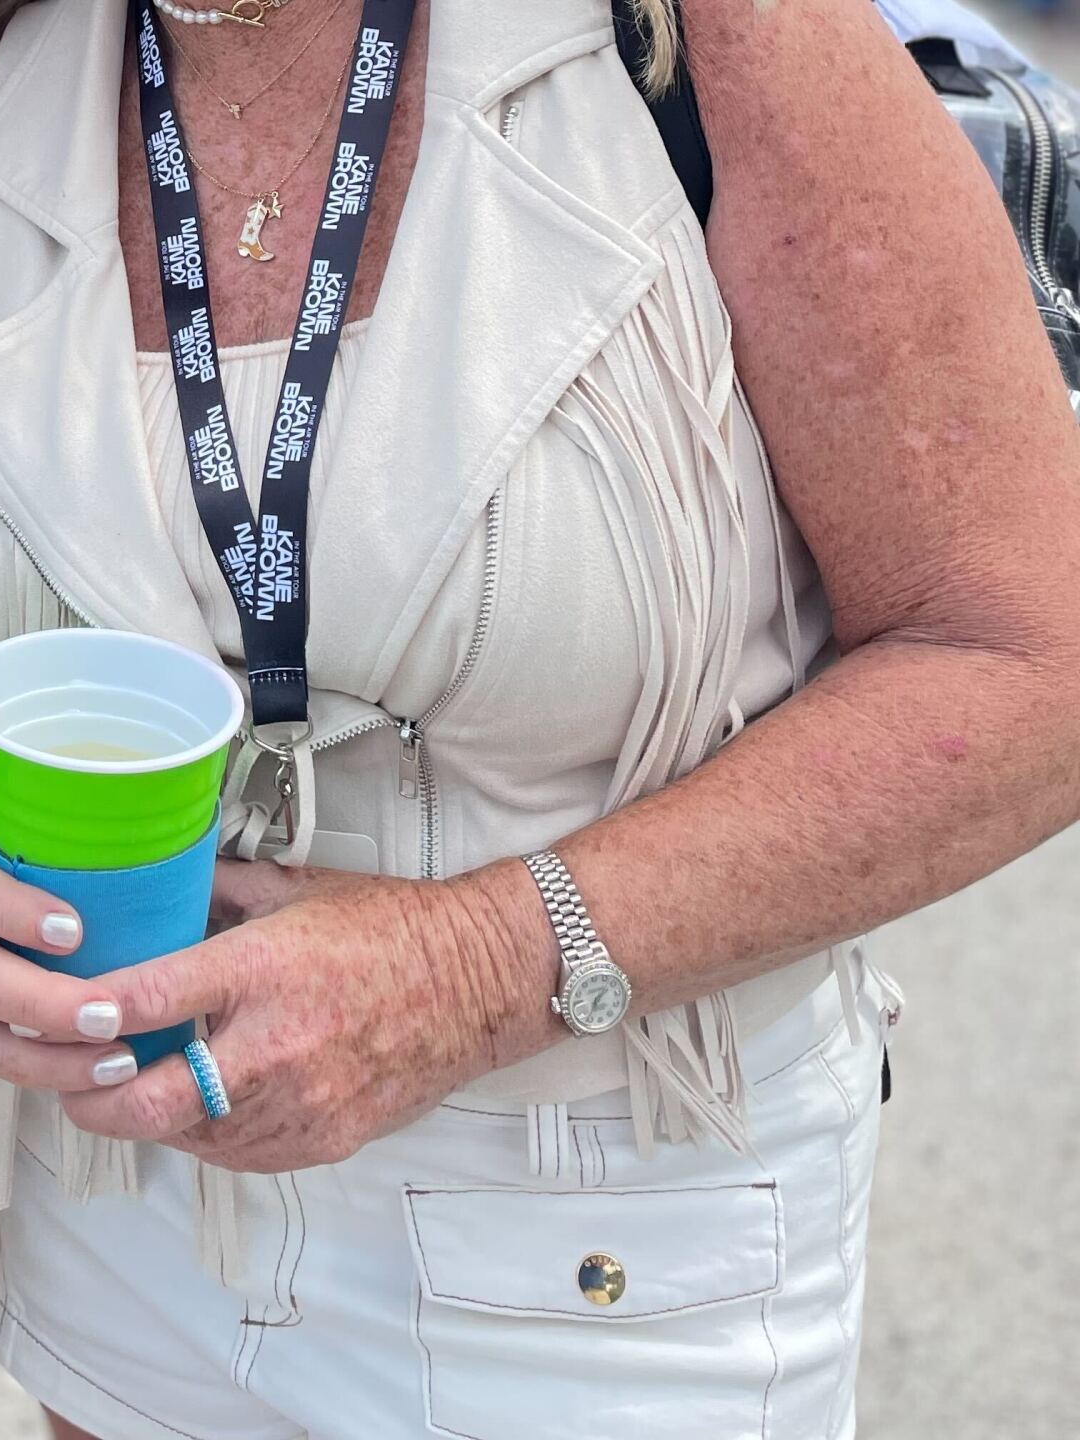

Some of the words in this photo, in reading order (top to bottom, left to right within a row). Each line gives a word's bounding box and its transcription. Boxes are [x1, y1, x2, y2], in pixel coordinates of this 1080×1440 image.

[140, 30, 154, 84] KANE
[142, 8, 165, 88] BROWN
[347, 27, 380, 114] BROWN
[367, 41, 394, 100] KANE
[151, 129, 174, 187] KANE
[159, 110, 190, 193] BROWN
[321, 142, 356, 230] BROWN
[341, 155, 370, 215] KANE
[167, 234, 187, 285] KANE
[180, 217, 204, 290] BROWN
[294, 259, 330, 351] BROWN
[314, 273, 343, 335] KANE
[178, 325, 199, 379] KANE
[190, 307, 216, 383] BROWN
[194, 425, 219, 485] KANE
[206, 404, 240, 492] BROWN
[266, 382, 301, 479] BROWN
[285, 395, 313, 462] KANE
[256, 514, 278, 621] BROWN
[275, 529, 294, 603] KANE
